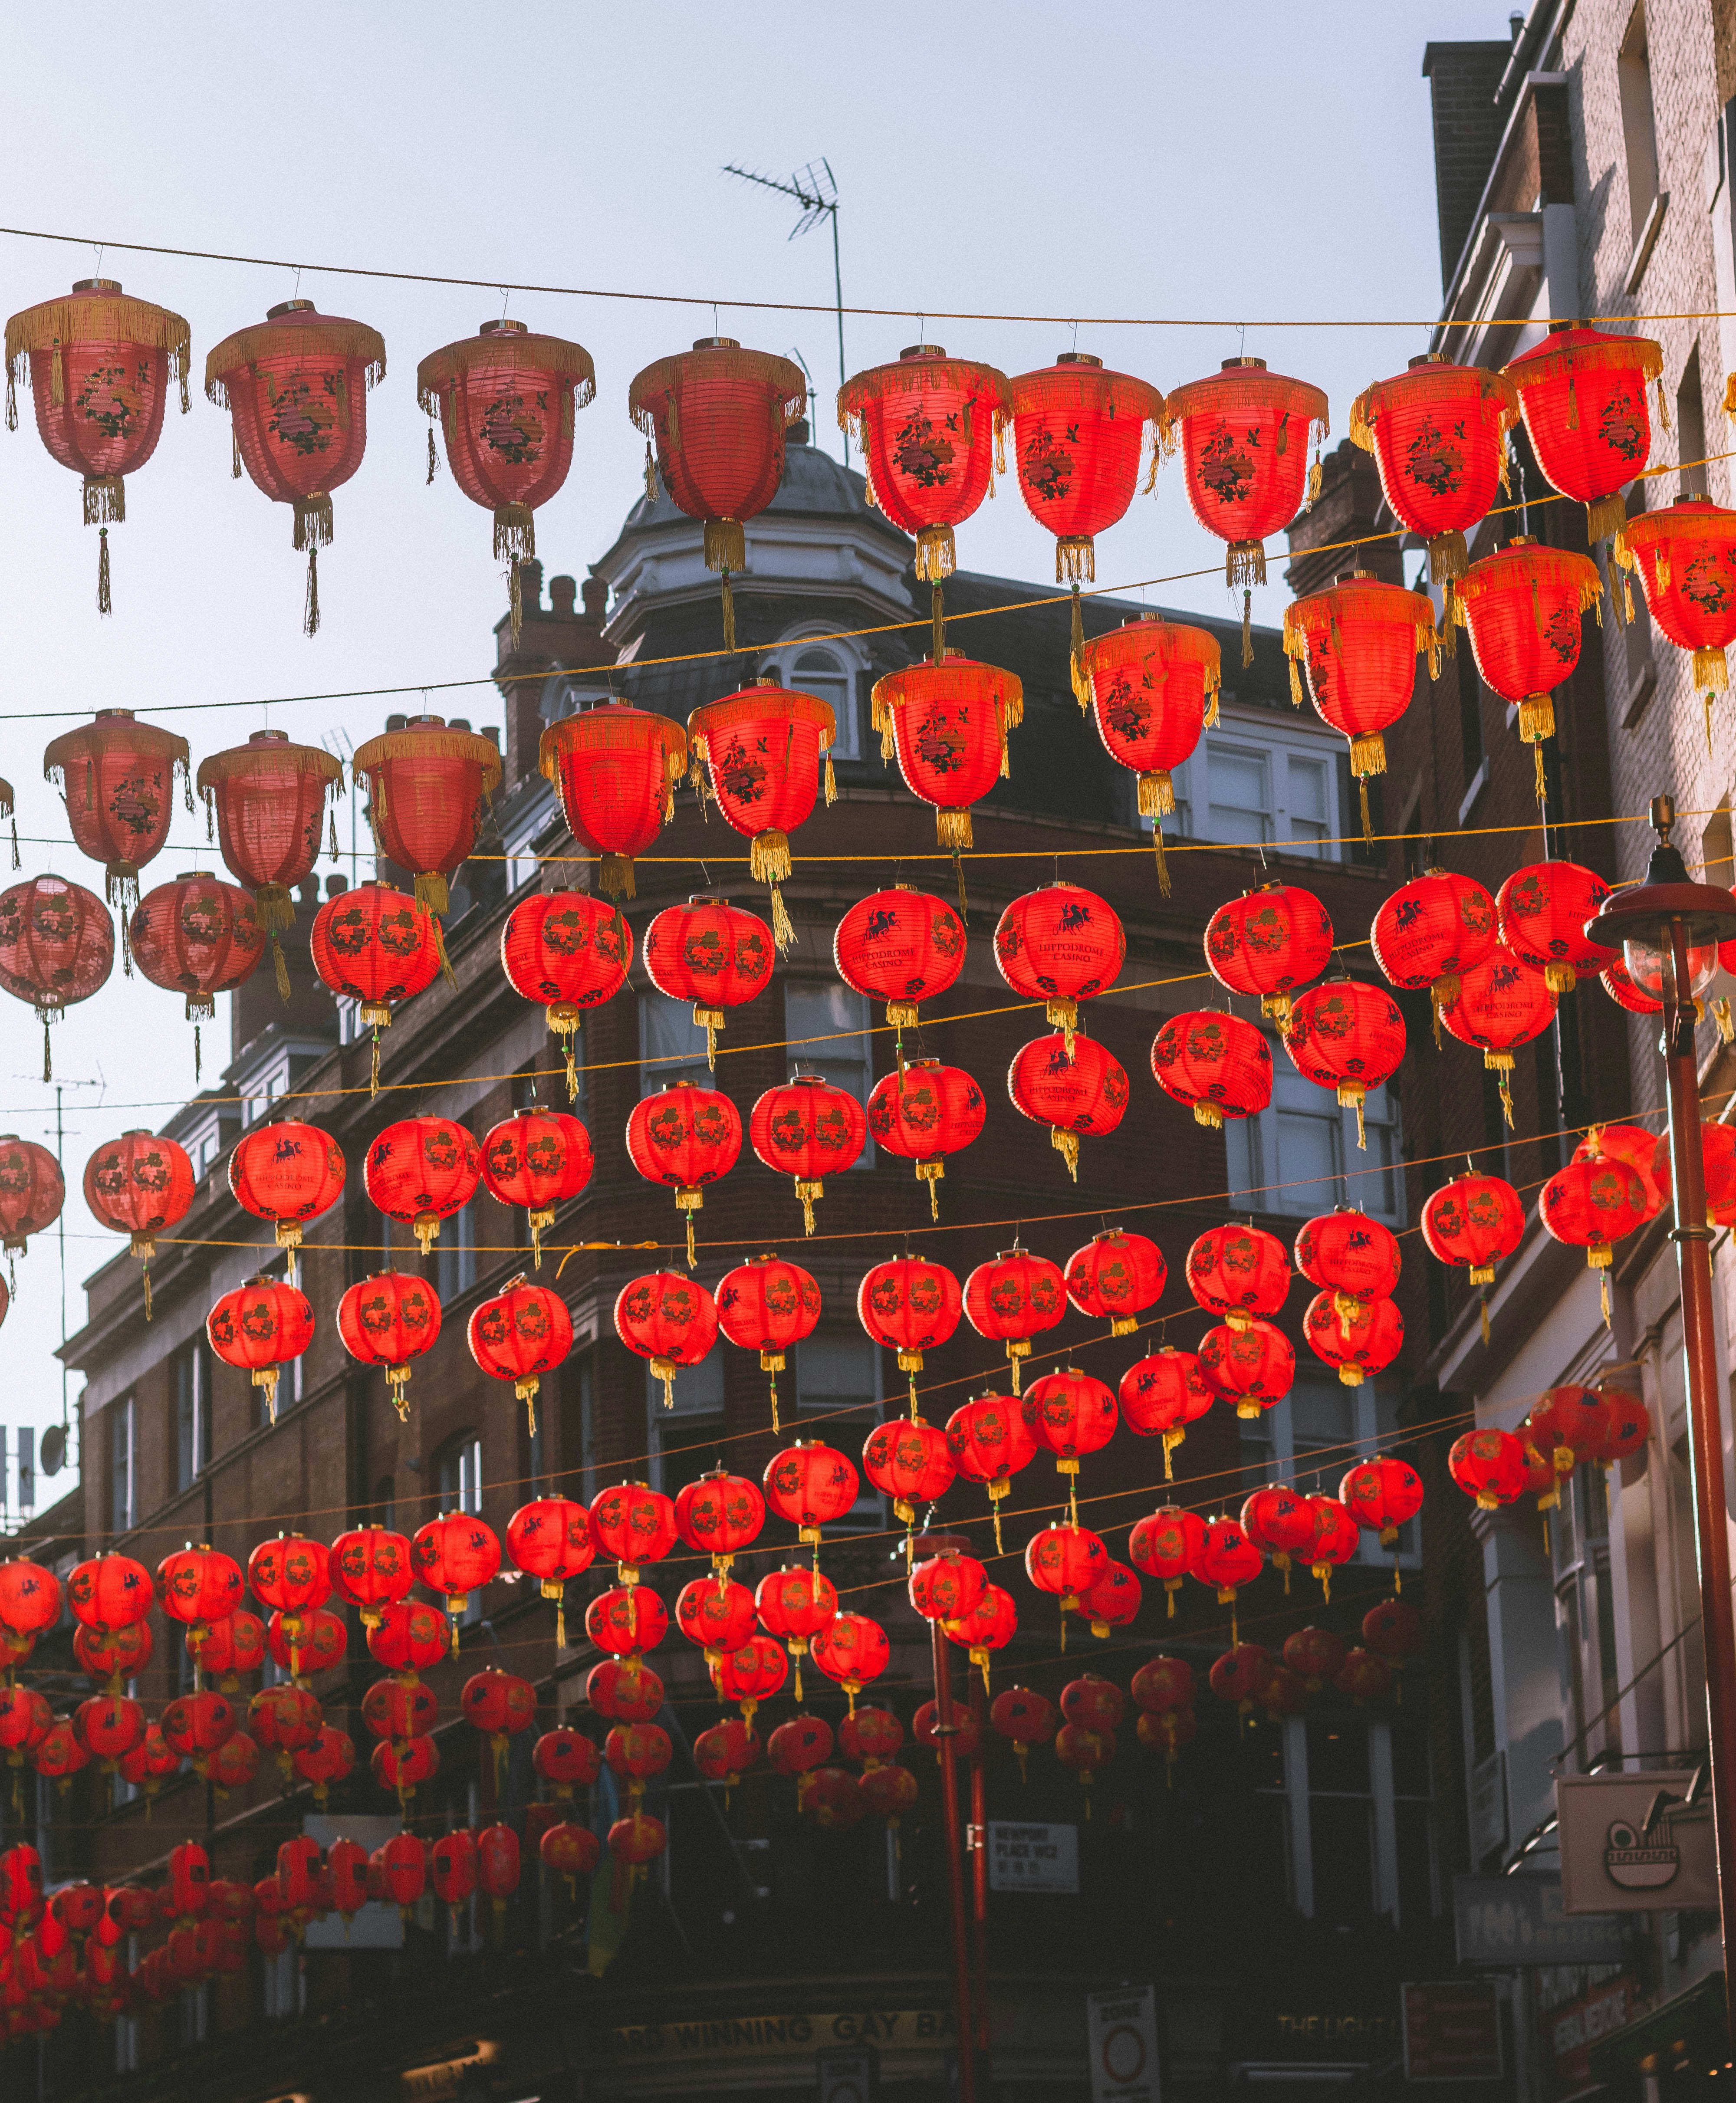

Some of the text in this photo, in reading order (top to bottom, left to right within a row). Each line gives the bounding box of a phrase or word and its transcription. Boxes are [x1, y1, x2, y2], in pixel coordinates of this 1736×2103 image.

[1039, 943, 1104, 956] HIPPODROME
[1389, 932, 1444, 960] HIPPODROME
[1401, 943, 1434, 960] CASINO
[852, 948, 915, 963] HIPPODROME
[1053, 953, 1091, 962] CASINO
[865, 959, 902, 969] CASINO
[1473, 1002, 1533, 1013] HIPPODROME
[1029, 1086, 1088, 1095] HIPPODROME
[1041, 1094, 1075, 1102] CASINO
[614, 2013, 957, 2052] ARD WINNING GAY BA
[1277, 2015, 1320, 2038] THE
